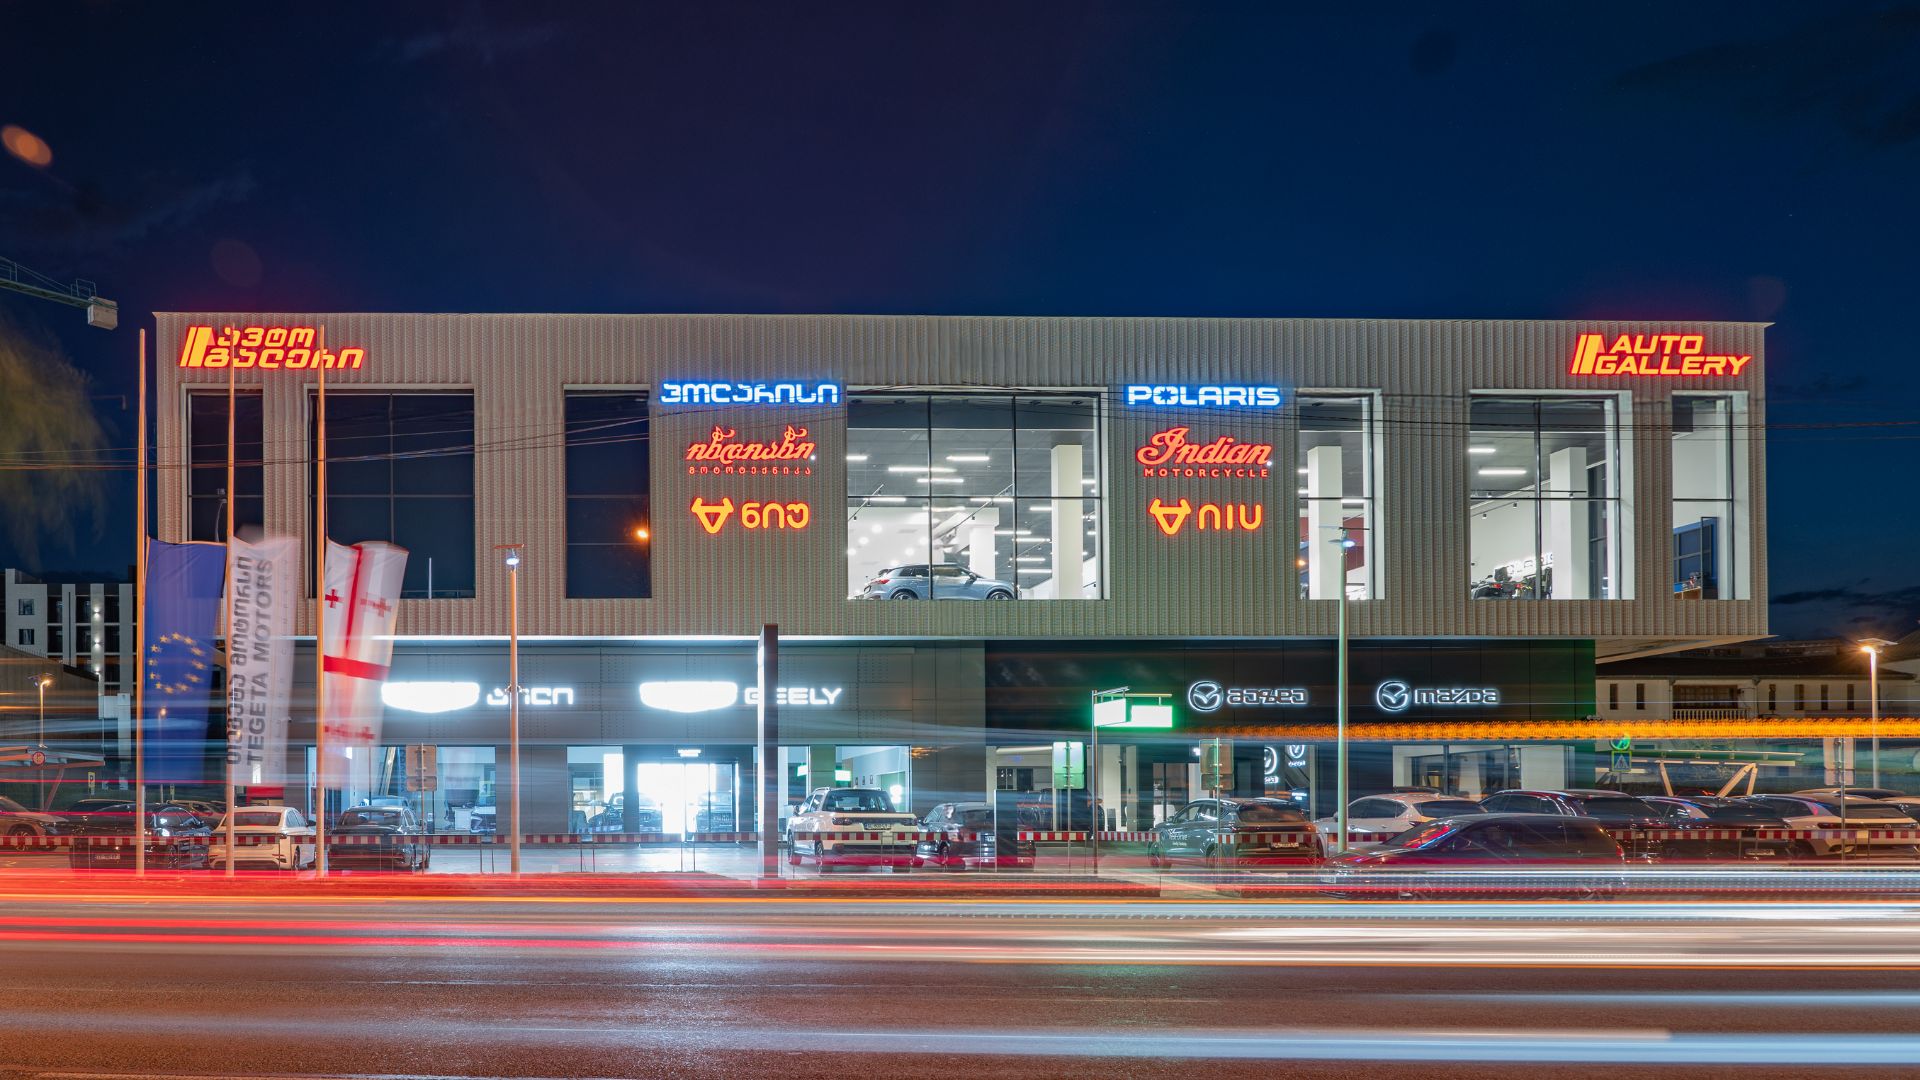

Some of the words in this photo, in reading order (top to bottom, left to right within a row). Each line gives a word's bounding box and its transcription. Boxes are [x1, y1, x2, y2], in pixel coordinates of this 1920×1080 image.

[217, 327, 315, 347] ავტო
[1609, 335, 1703, 354] AUTO
[203, 347, 364, 369] გალერი
[1594, 356, 1751, 375] GALLERY
[661, 383, 838, 403] პოლარისი
[1128, 386, 1281, 406] POLARIS
[686, 425, 815, 465] ინდიანი
[1137, 427, 1272, 465] Indian
[1144, 468, 1268, 477] MOTORCYCLE
[741, 502, 809, 529] ნიუ
[252, 559, 272, 663] MOTORS
[247, 673, 268, 766] TEGETA
